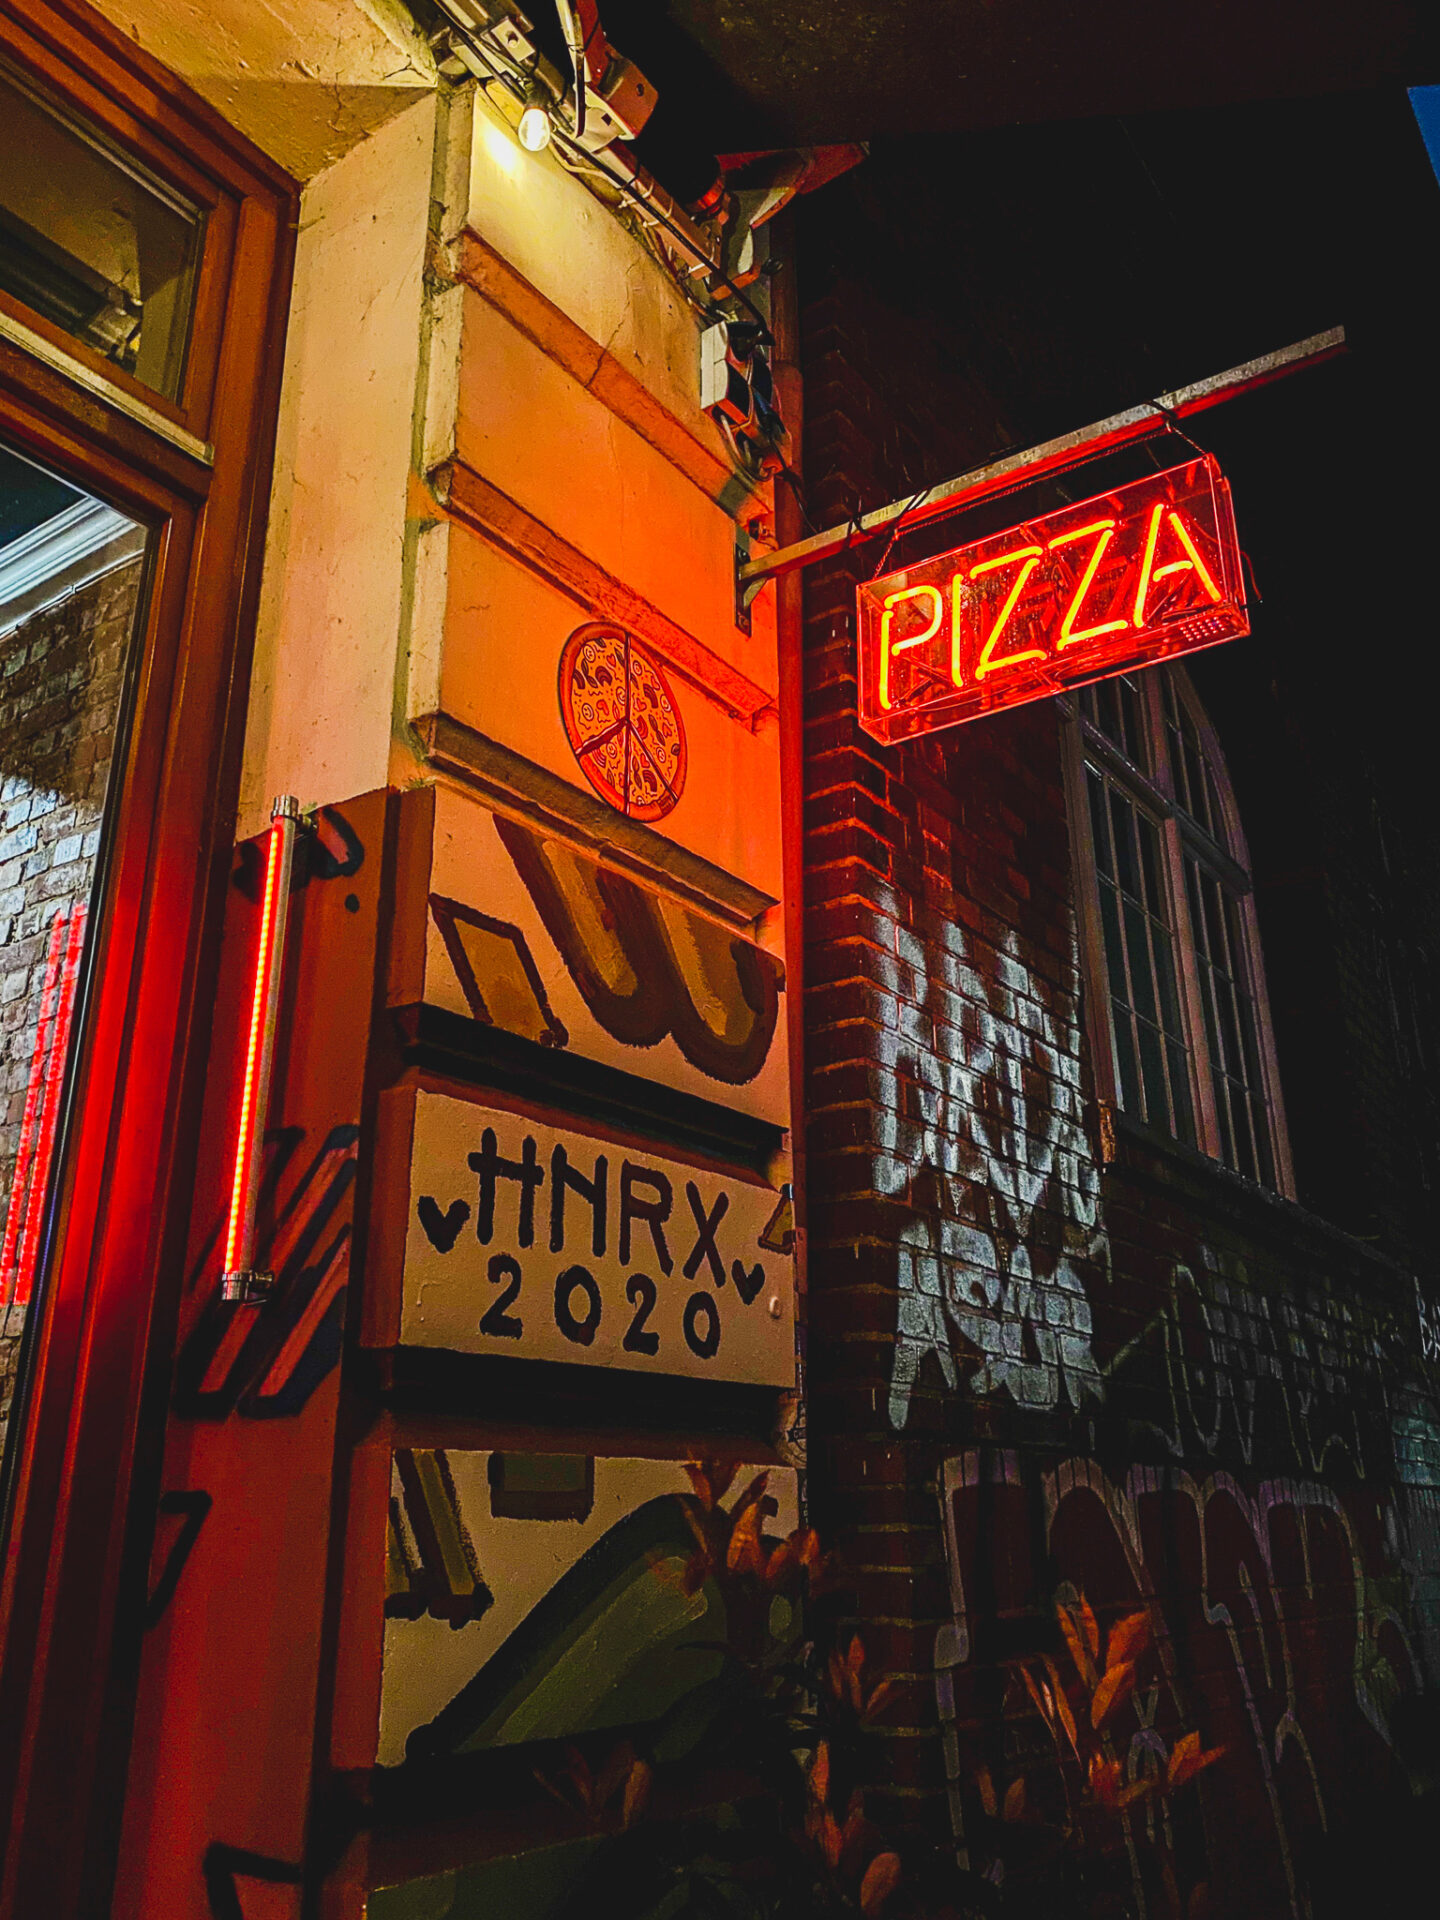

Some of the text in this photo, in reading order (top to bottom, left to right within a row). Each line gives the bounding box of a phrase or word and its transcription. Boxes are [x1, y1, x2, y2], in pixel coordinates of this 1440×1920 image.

[880, 502, 1223, 710] PIZZA
[467, 1126, 729, 1288] HNRX
[478, 1251, 721, 1360] 2020
